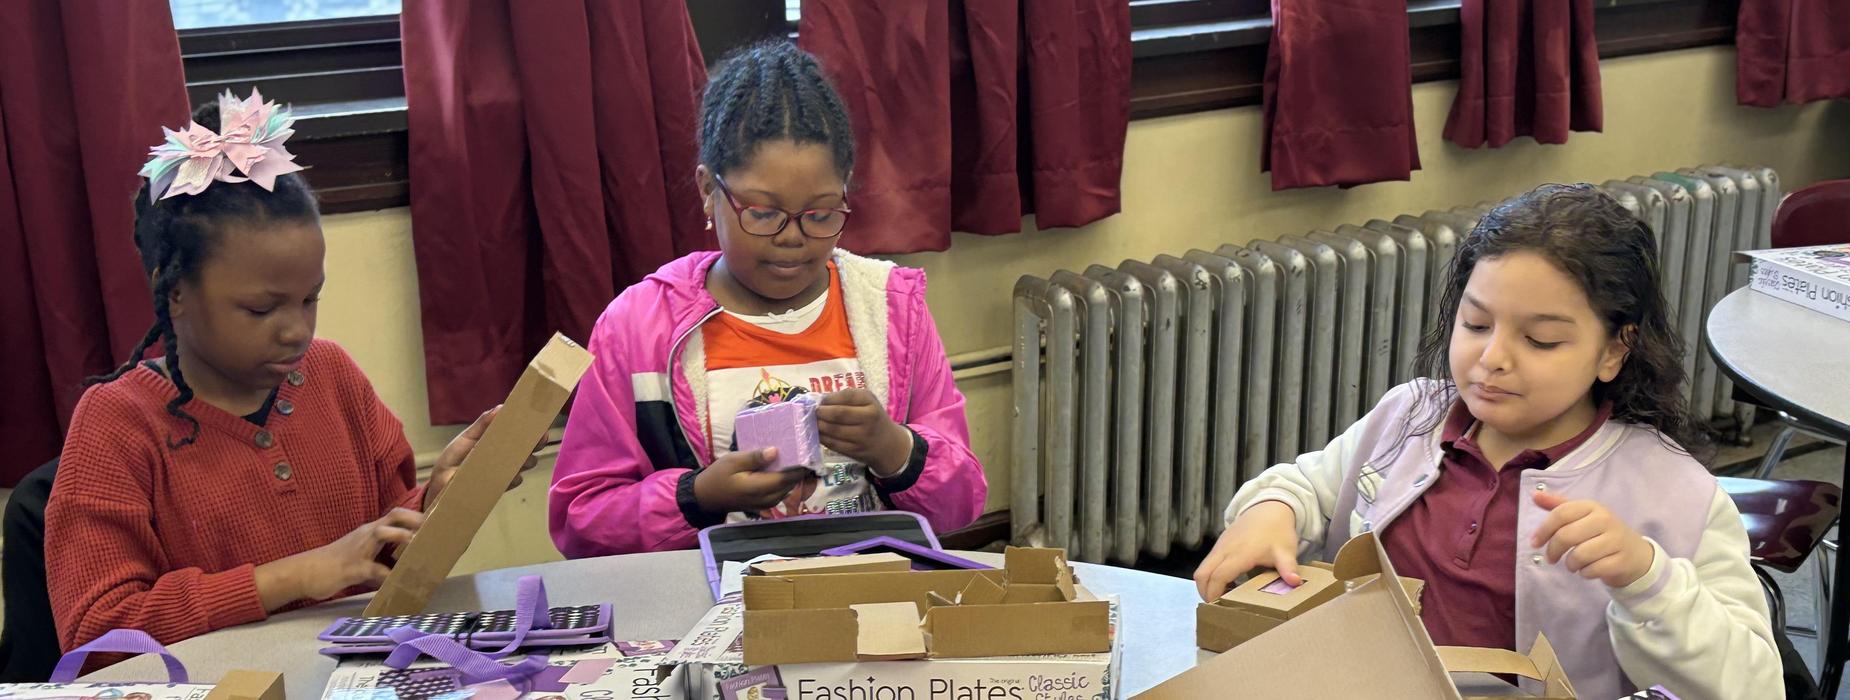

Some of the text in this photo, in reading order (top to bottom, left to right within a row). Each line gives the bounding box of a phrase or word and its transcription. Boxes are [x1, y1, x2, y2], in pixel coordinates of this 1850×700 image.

[1782, 274, 1818, 301] Plates
[798, 676, 1021, 700] Fashion Plates
[1028, 671, 1090, 692] Classic
